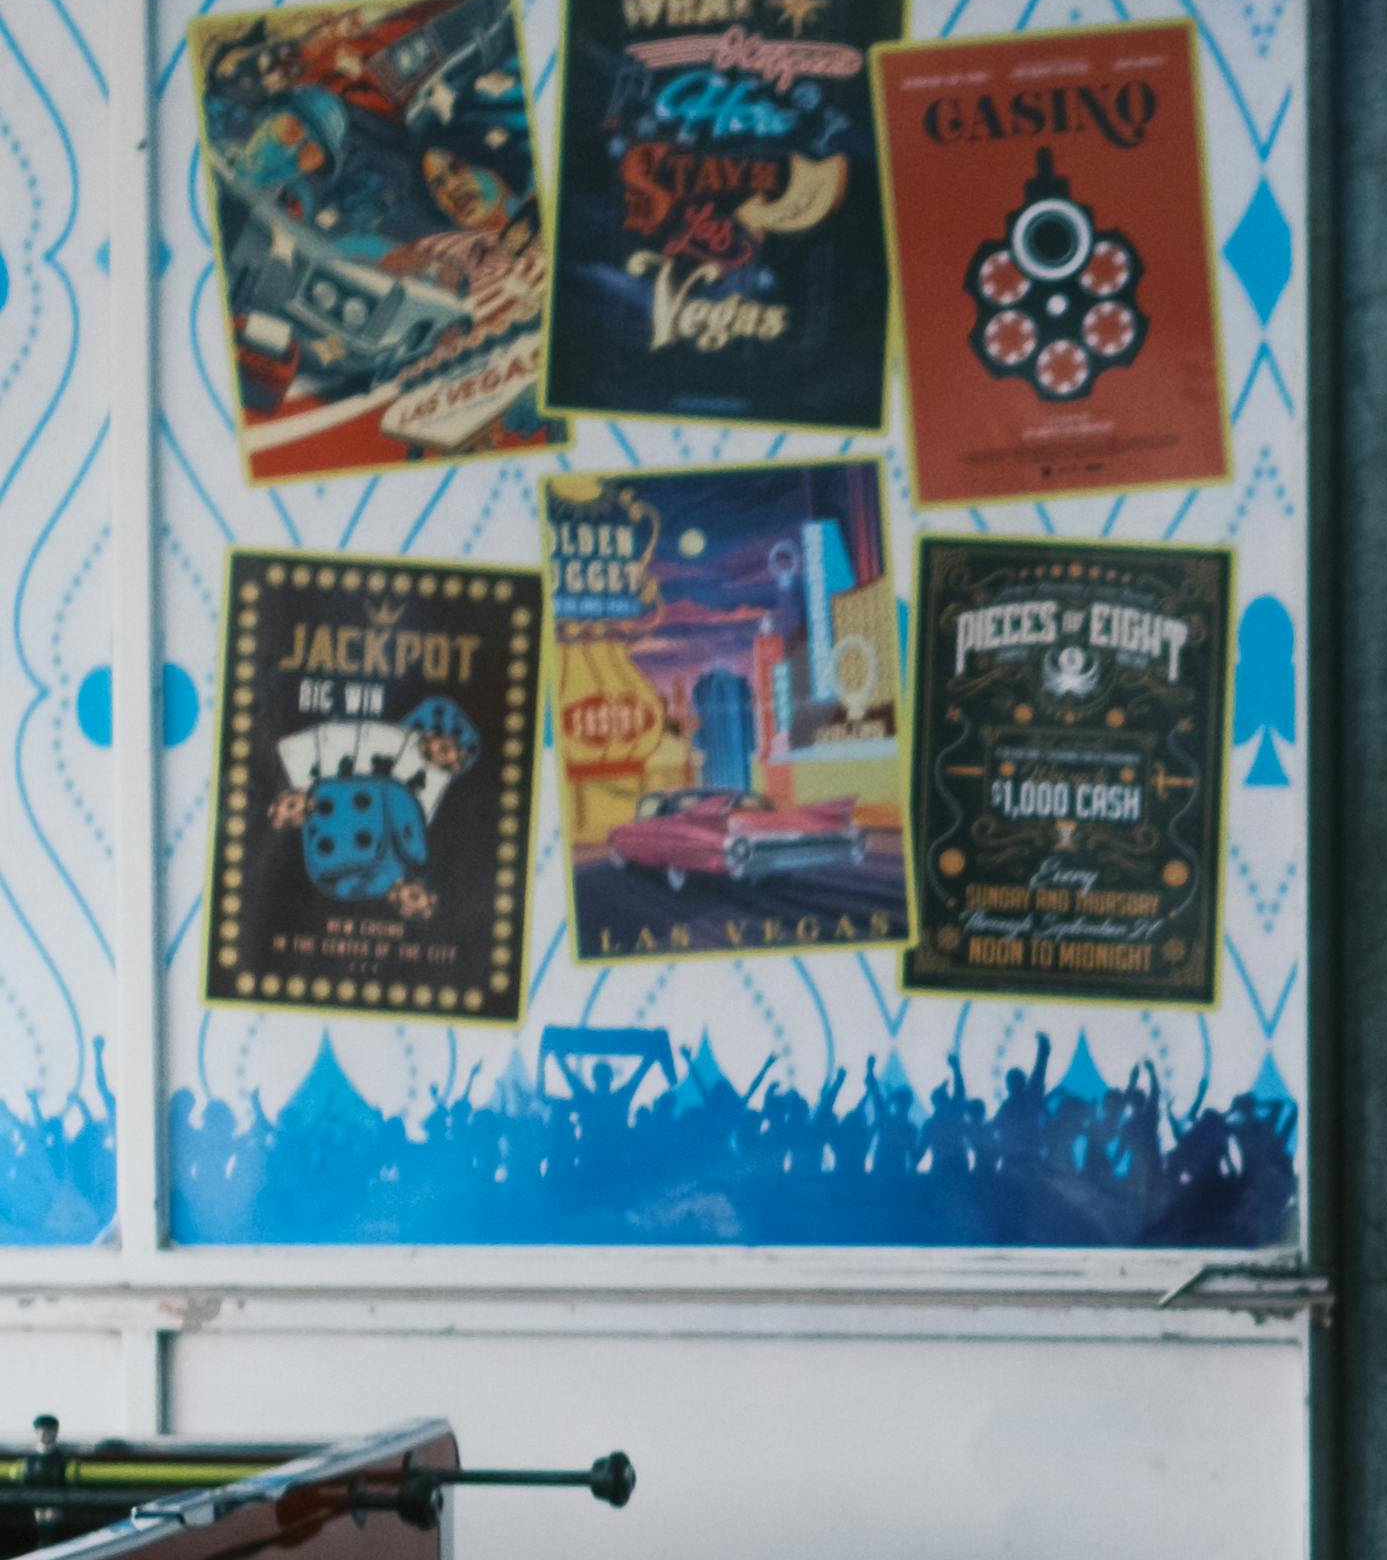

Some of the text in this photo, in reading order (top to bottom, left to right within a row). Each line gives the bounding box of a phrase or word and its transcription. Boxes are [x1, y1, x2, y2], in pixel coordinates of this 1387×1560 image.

[922, 79, 1160, 149] CASINO
[626, 248, 790, 351] Vegas
[401, 396, 440, 425] LAS
[278, 621, 482, 684] JACKPOT
[955, 600, 1057, 676] PIECES
[1089, 602, 1189, 682] EIGHT
[298, 679, 385, 718] BIG WIN
[991, 780, 1141, 820] $1,000 CASH
[968, 935, 1152, 972] NOON TO MIDNIGHT
